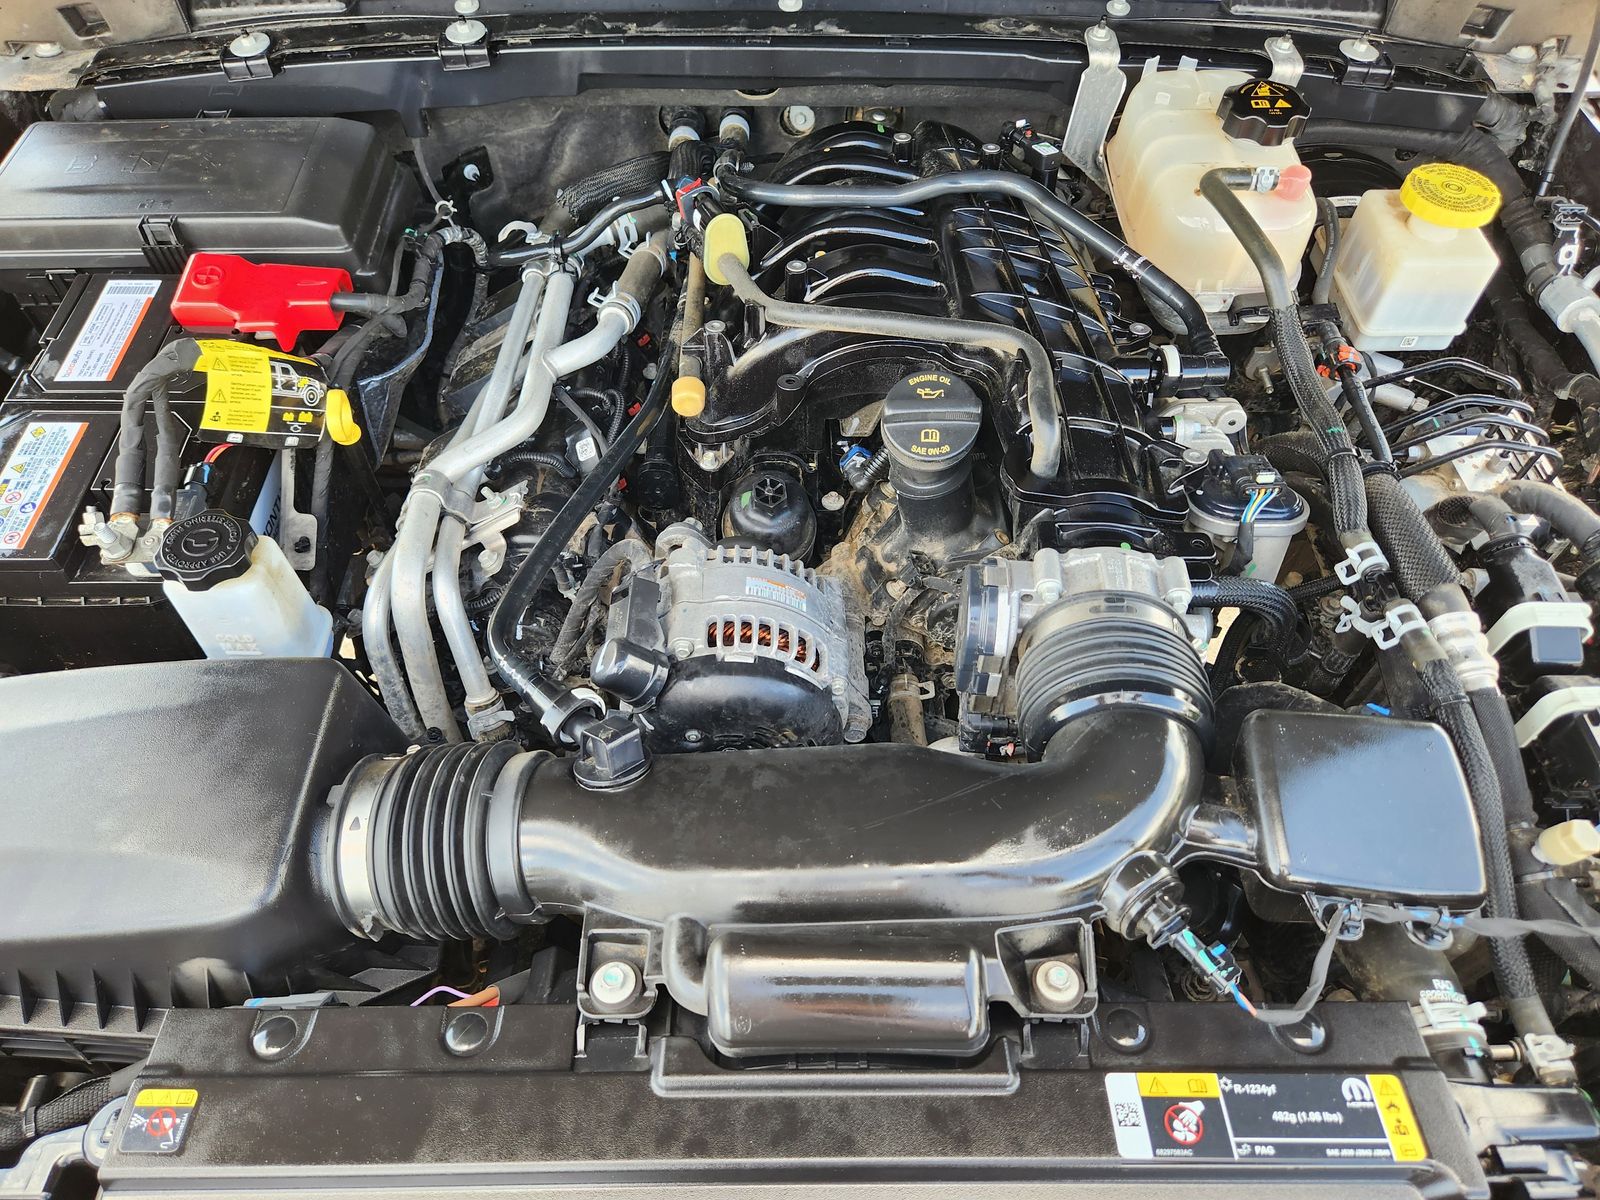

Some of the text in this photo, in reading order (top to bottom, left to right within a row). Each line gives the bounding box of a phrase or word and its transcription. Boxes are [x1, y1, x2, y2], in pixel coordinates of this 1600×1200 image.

[908, 374, 952, 386] ENGINE OIL
[911, 444, 951, 455] SAE 0W-20
[166, 526, 184, 545] FLUID
[166, 551, 227, 569] USE APPROVED
[1432, 978, 1453, 990] RAD
[1233, 1083, 1277, 1097] R-1234yf
[1322, 1111, 1343, 1125] lbs)
[1254, 1145, 1276, 1157] PAG
